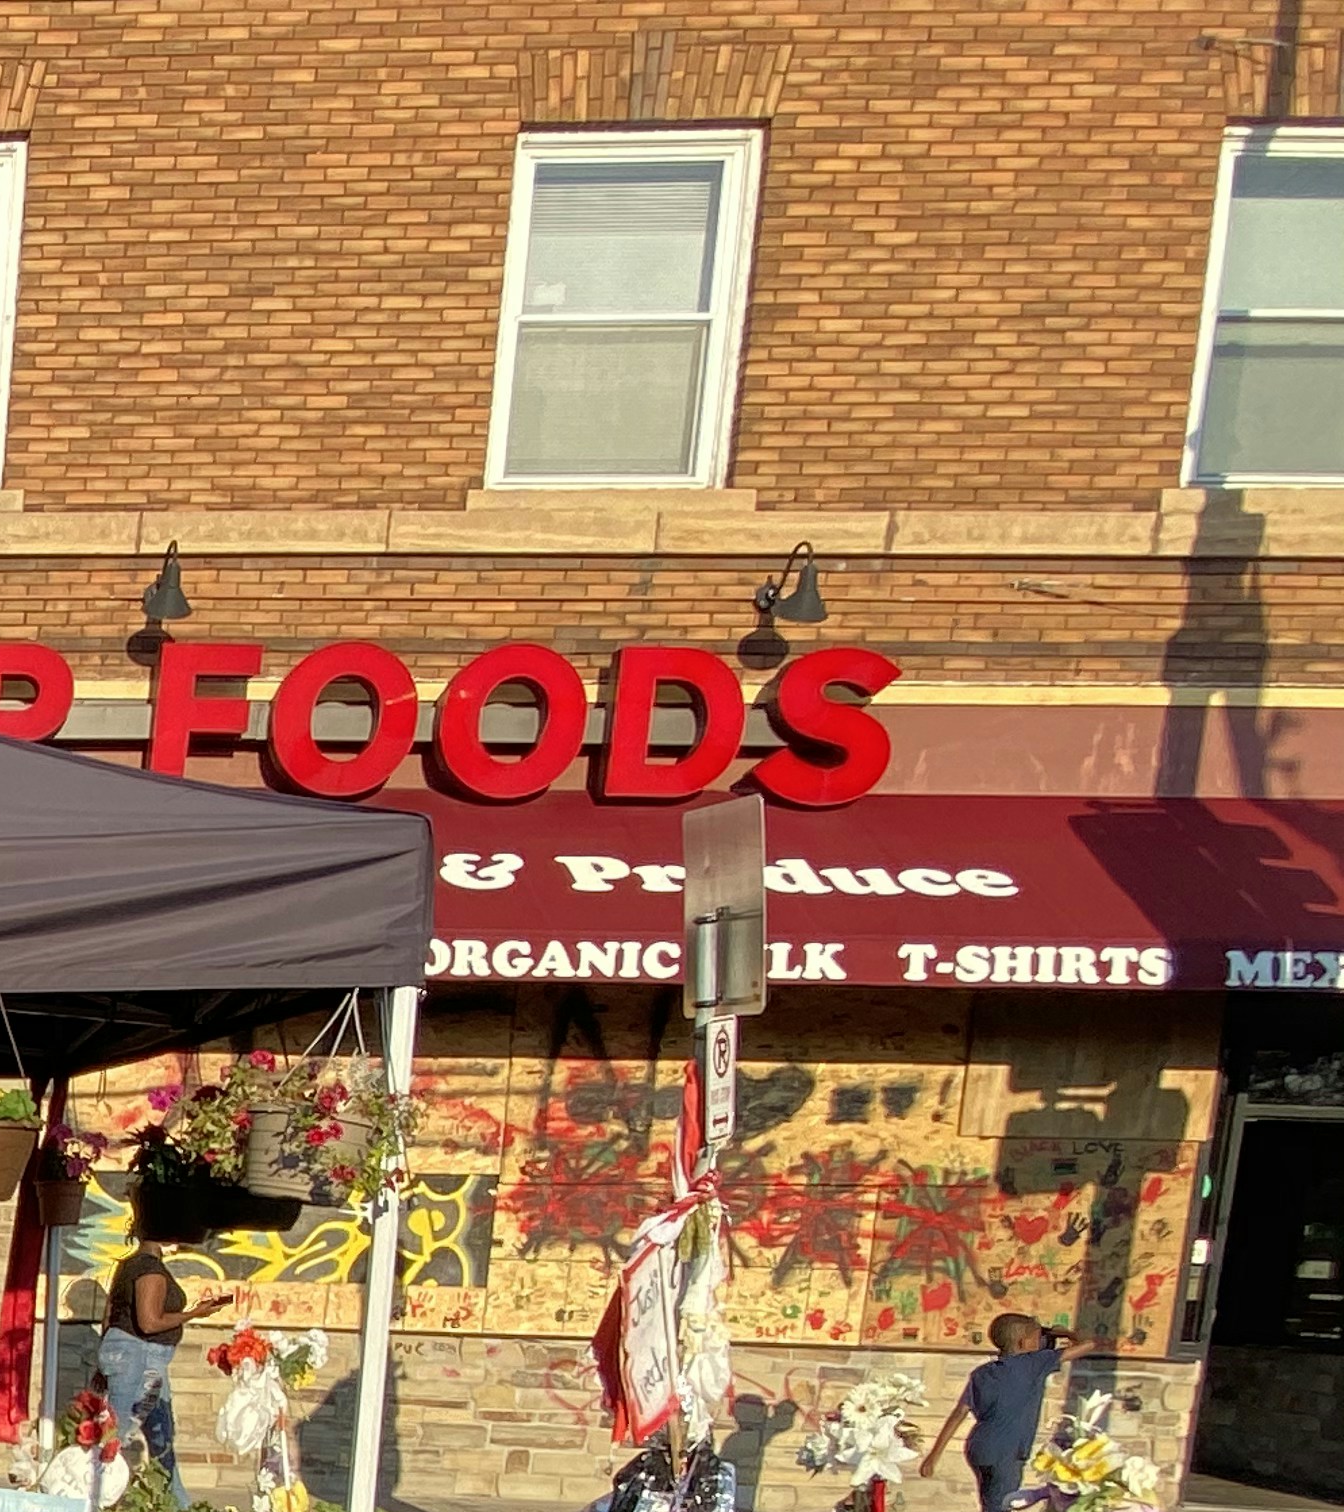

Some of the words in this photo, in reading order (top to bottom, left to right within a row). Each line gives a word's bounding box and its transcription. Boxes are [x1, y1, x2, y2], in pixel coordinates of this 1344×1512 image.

[150, 642, 902, 806] FOODS
[440, 853, 523, 889] &
[555, 856, 1019, 897] Prduce
[898, 944, 1174, 985] T-SHIRTS
[1072, 1141, 1125, 1156] LOVE
